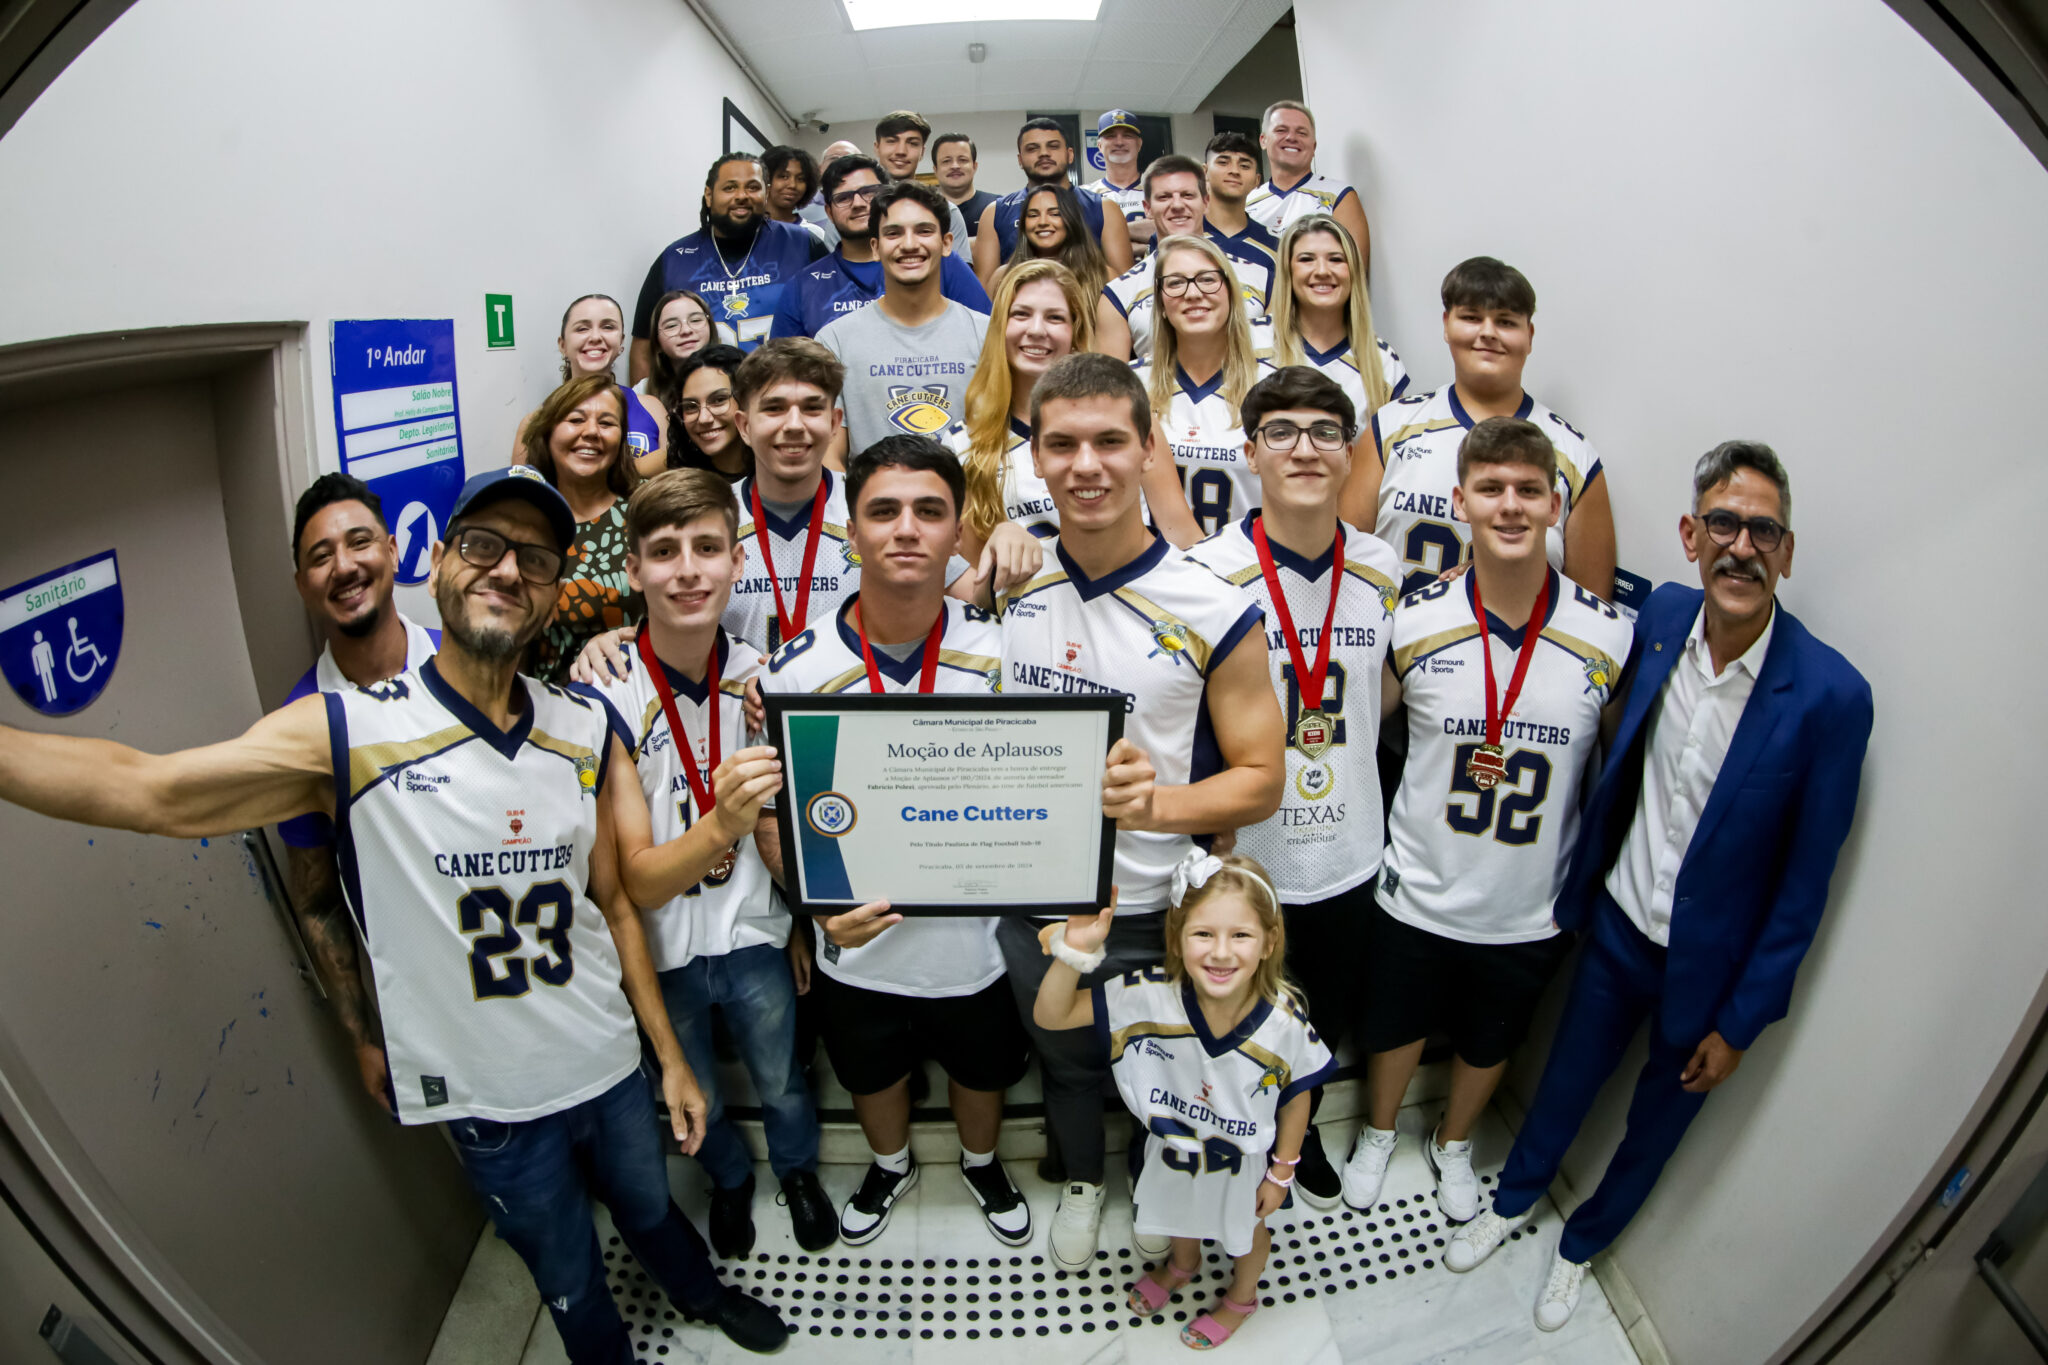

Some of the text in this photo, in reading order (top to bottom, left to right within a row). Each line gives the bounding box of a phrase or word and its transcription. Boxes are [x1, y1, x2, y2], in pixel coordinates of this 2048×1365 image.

[701, 281, 726, 296] CANE
[494, 304, 506, 338] T
[384, 343, 427, 366] Andar
[895, 355, 940, 364] PIRACICABA
[870, 362, 966, 377] CANE CUTTERS
[412, 386, 452, 401] Salão Nobre
[886, 392, 952, 411] CANE CUTTERS
[399, 421, 455, 441] Depto. Legislativo
[426, 445, 457, 460] Sanitários
[1177, 446, 1237, 462] CUTTERS
[1007, 500, 1043, 520] CANE
[1394, 490, 1447, 519] CANE
[26, 574, 87, 613] Sanitário
[735, 578, 772, 597] CANE
[1016, 608, 1036, 619] Sports
[1018, 600, 1048, 612] Surmount
[1431, 658, 1465, 667] Surmount
[1431, 666, 1455, 676] Sports
[1013, 661, 1051, 689] CANE
[912, 717, 1037, 727] Câmara Municipal de Piracicaba
[887, 741, 1063, 762] Moção de Aplausos
[406, 781, 439, 794] Sports
[1444, 742, 1553, 848] 52
[901, 805, 1049, 822] Cane Cutters
[1279, 803, 1346, 826] TEXAS
[434, 843, 574, 878] CANE CUTTERS
[456, 877, 574, 1002] 23
[1149, 1087, 1187, 1115] CANE
[1188, 1104, 1257, 1137] CUTTERS
